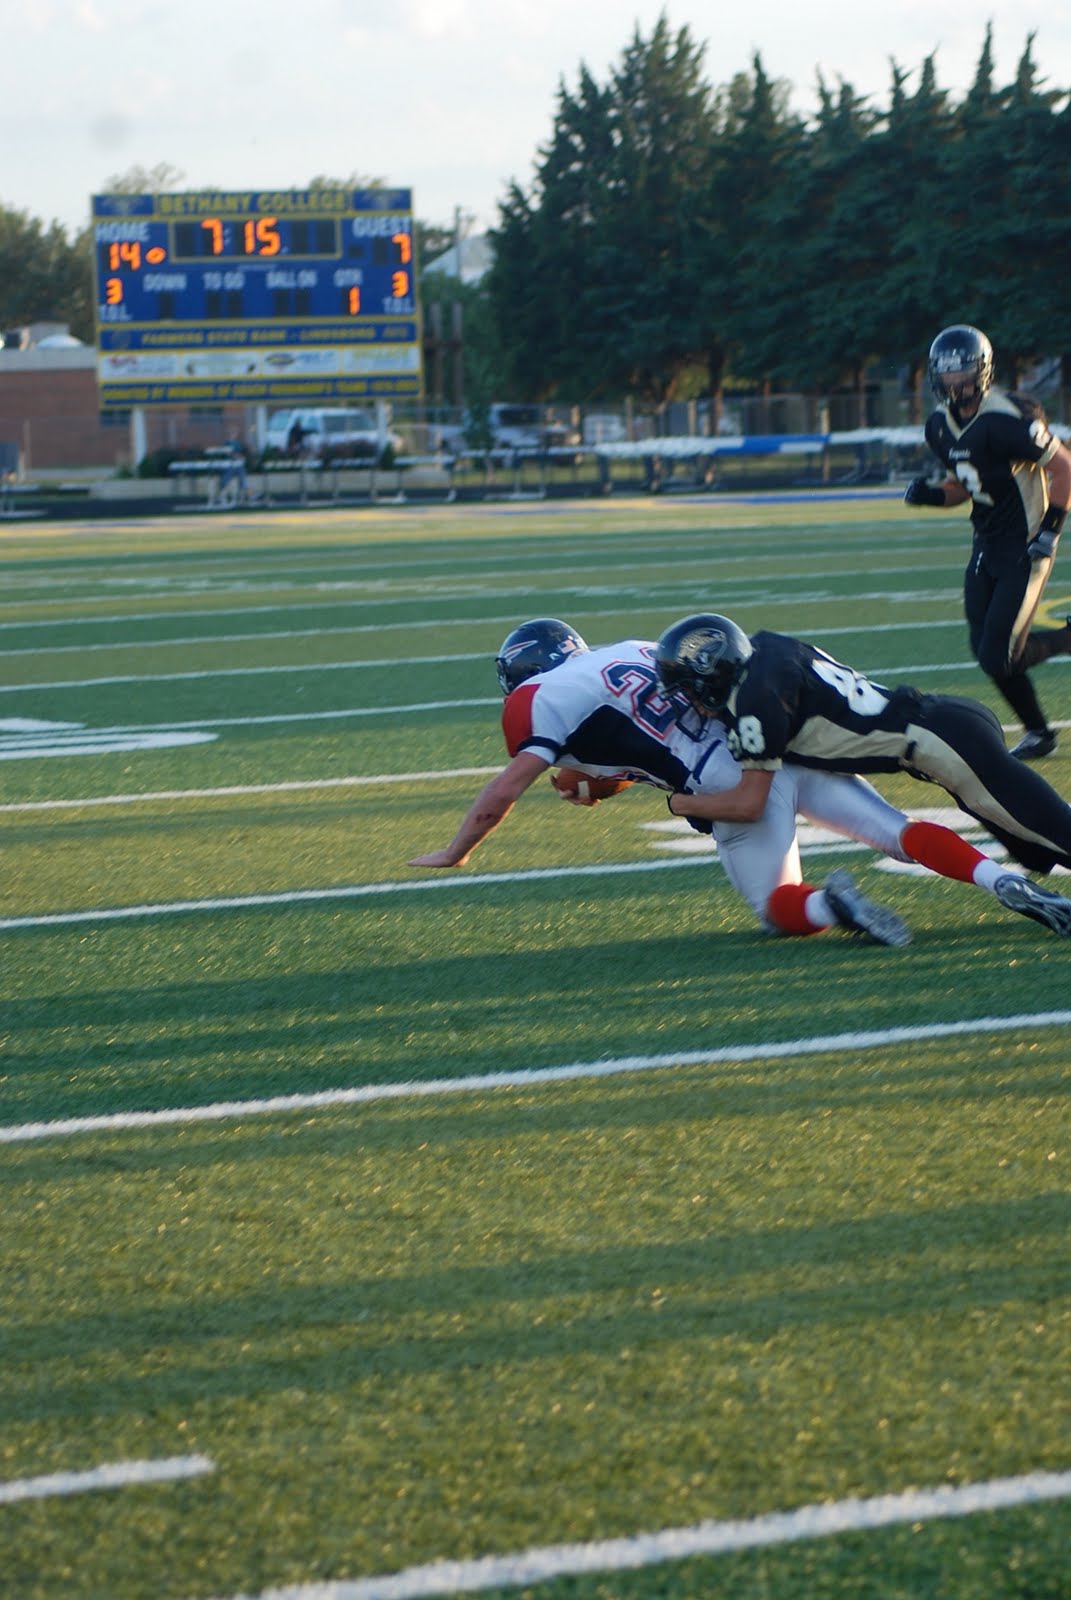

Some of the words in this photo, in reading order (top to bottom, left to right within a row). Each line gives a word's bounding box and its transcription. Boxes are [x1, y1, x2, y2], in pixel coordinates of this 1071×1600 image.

[159, 193, 252, 214] BETHANY
[256, 190, 347, 211] COLLEGE
[96, 221, 150, 242] HOME
[352, 216, 411, 237] GUEST
[109, 242, 141, 271] 14
[392, 233, 412, 264] 7
[106, 278, 123, 305] 3
[143, 273, 188, 292] DOWN
[392, 270, 409, 298] 3
[349, 286, 361, 315] 1
